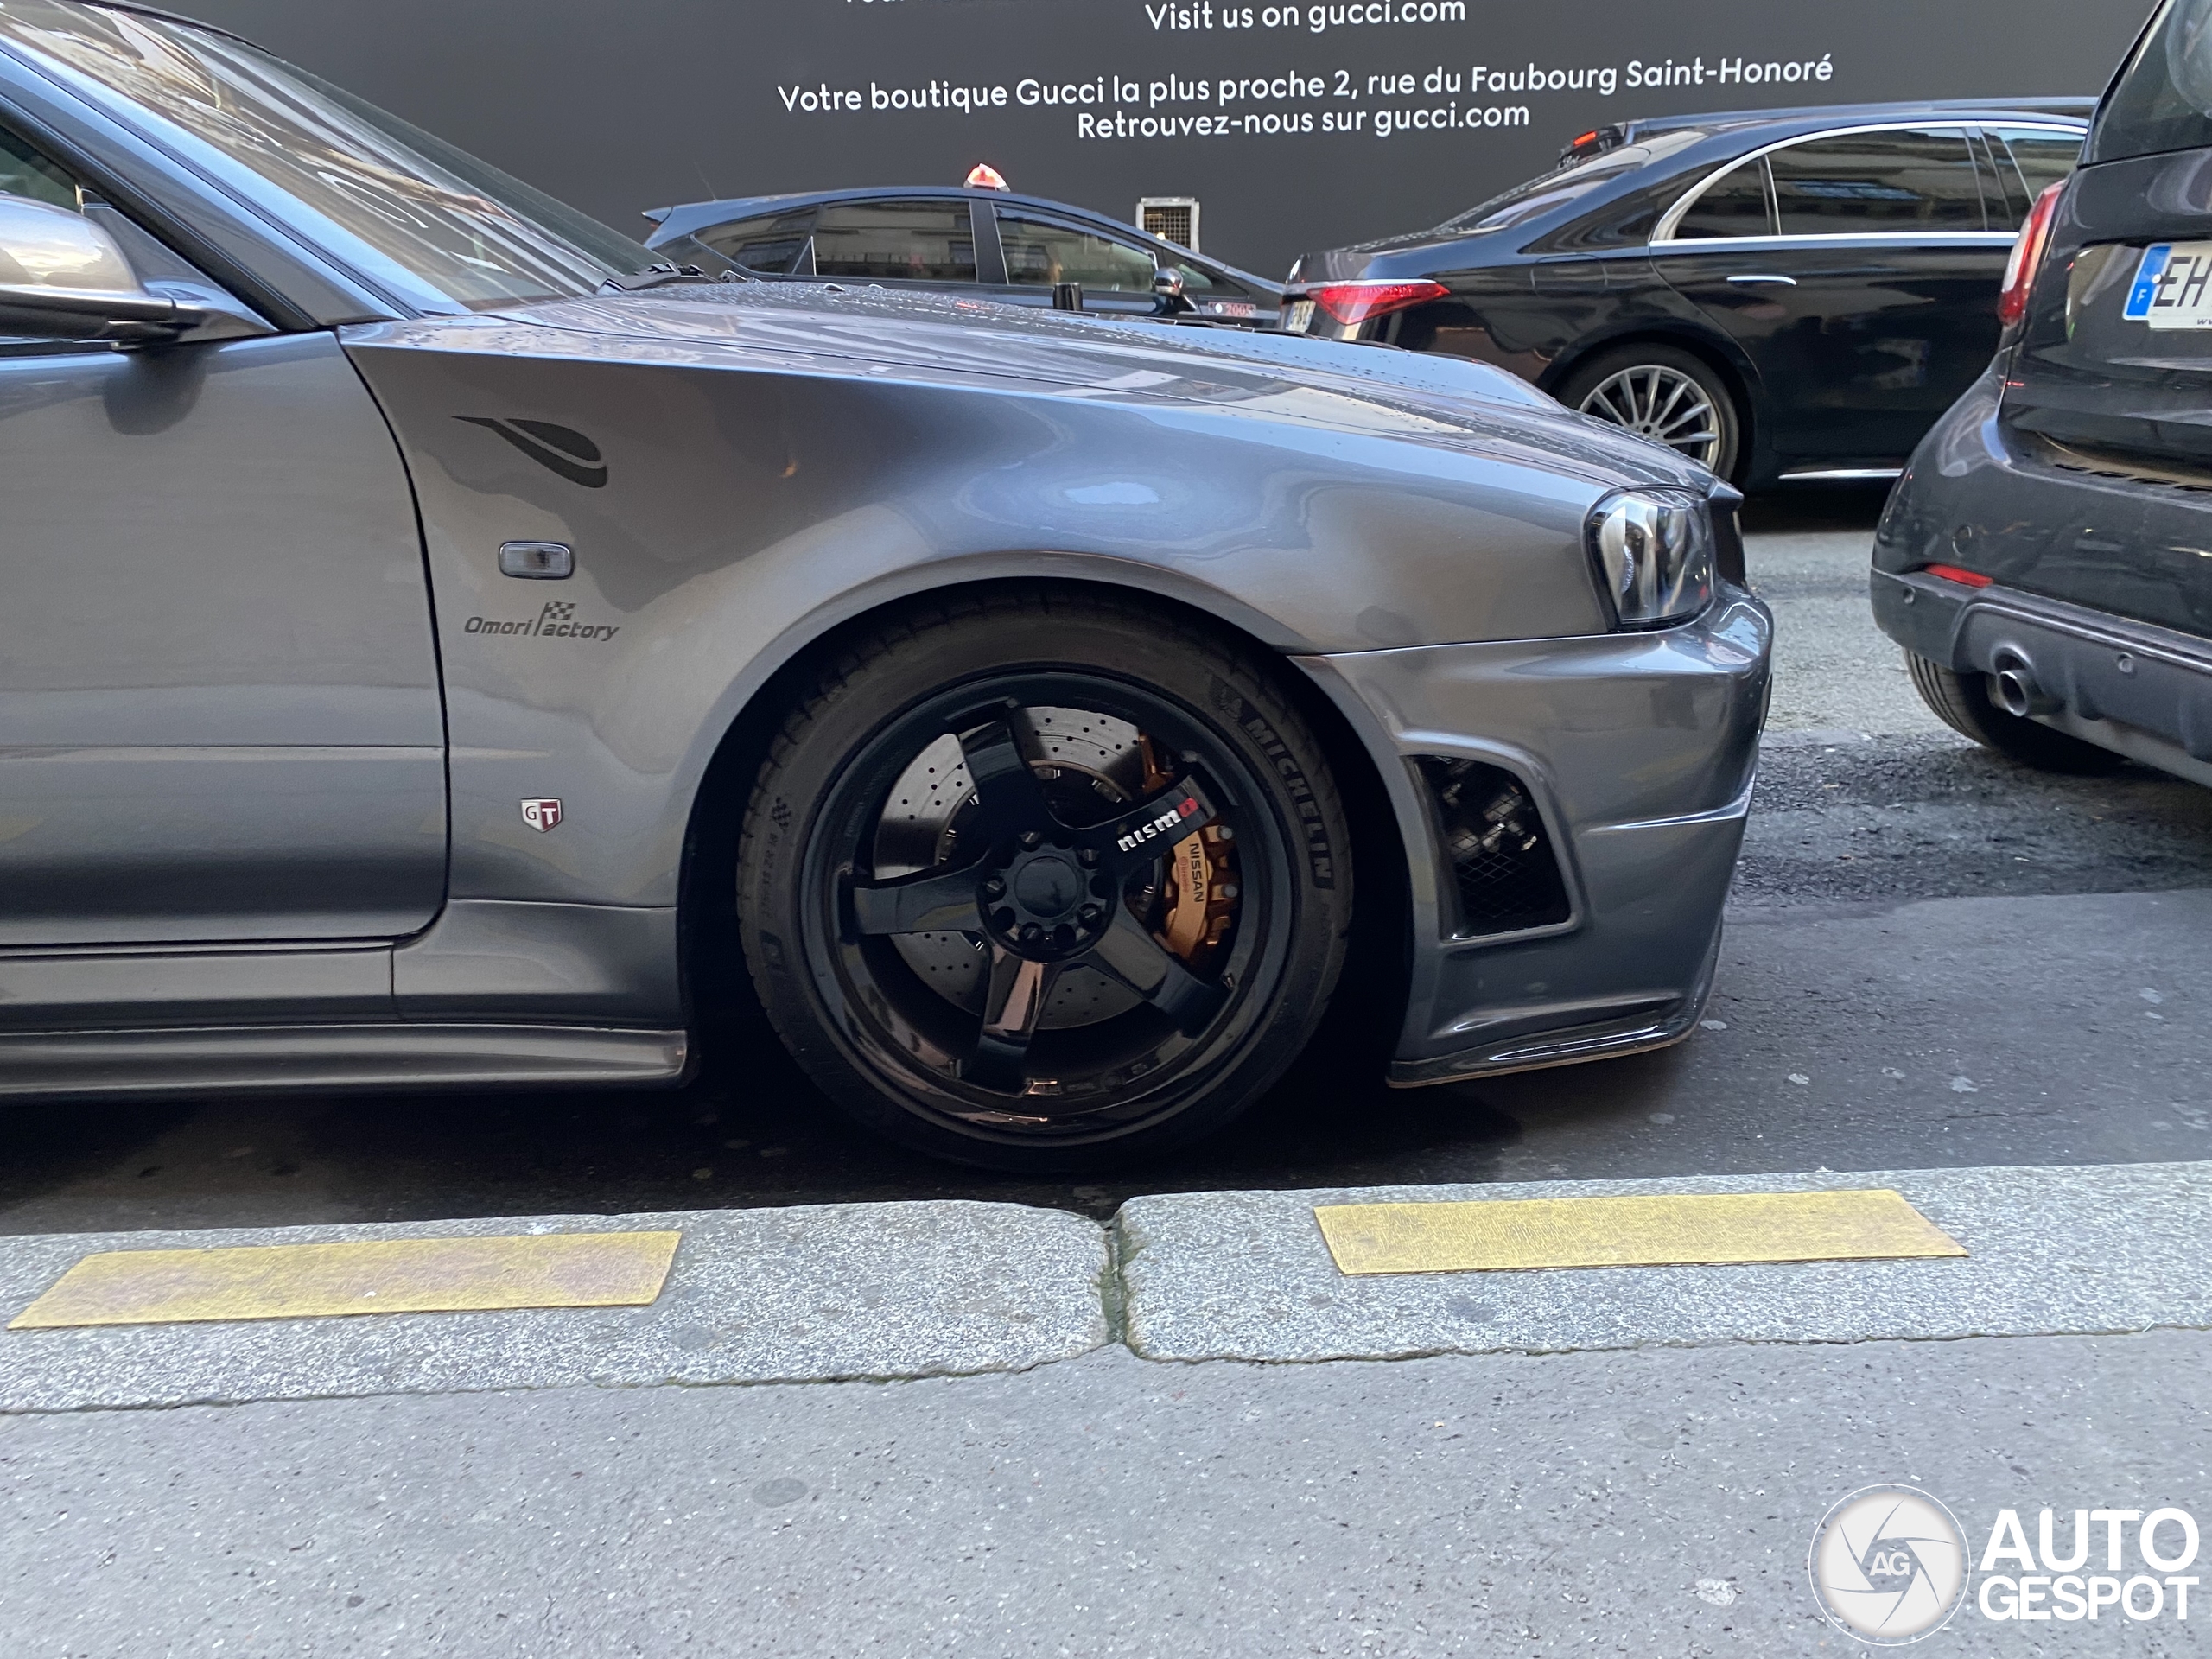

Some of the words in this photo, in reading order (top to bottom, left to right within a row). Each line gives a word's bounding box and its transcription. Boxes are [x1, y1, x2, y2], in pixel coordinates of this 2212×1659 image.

[1145, 0, 1213, 31] Visit
[1222, 8, 1254, 29] us
[1262, 6, 1300, 28] on
[1307, 0, 1465, 34] gucci.com
[778, 83, 862, 112] Votre
[870, 79, 1008, 114] boutique
[1015, 75, 1104, 105] Gucci
[1113, 74, 1140, 103] la
[1149, 73, 1211, 109] plus
[1218, 69, 1325, 107] proche
[1332, 69, 1359, 101] 2,
[1367, 73, 1416, 95] rue
[1423, 65, 1461, 94] du
[1471, 62, 1618, 96] Faubourg
[1625, 52, 1834, 89] Saint-Honoré
[1077, 110, 1313, 139] Retrouvez-nous
[1321, 111, 1367, 132] sur
[1374, 100, 1529, 137] gucci.com
[2136, 289, 2147, 303] F
[2153, 257, 2212, 307] EH
[465, 616, 533, 635] Omori
[525, 805, 556, 825] GT
[1246, 718, 1332, 879] MICHELIN
[1189, 843, 1204, 903] NISSAN
